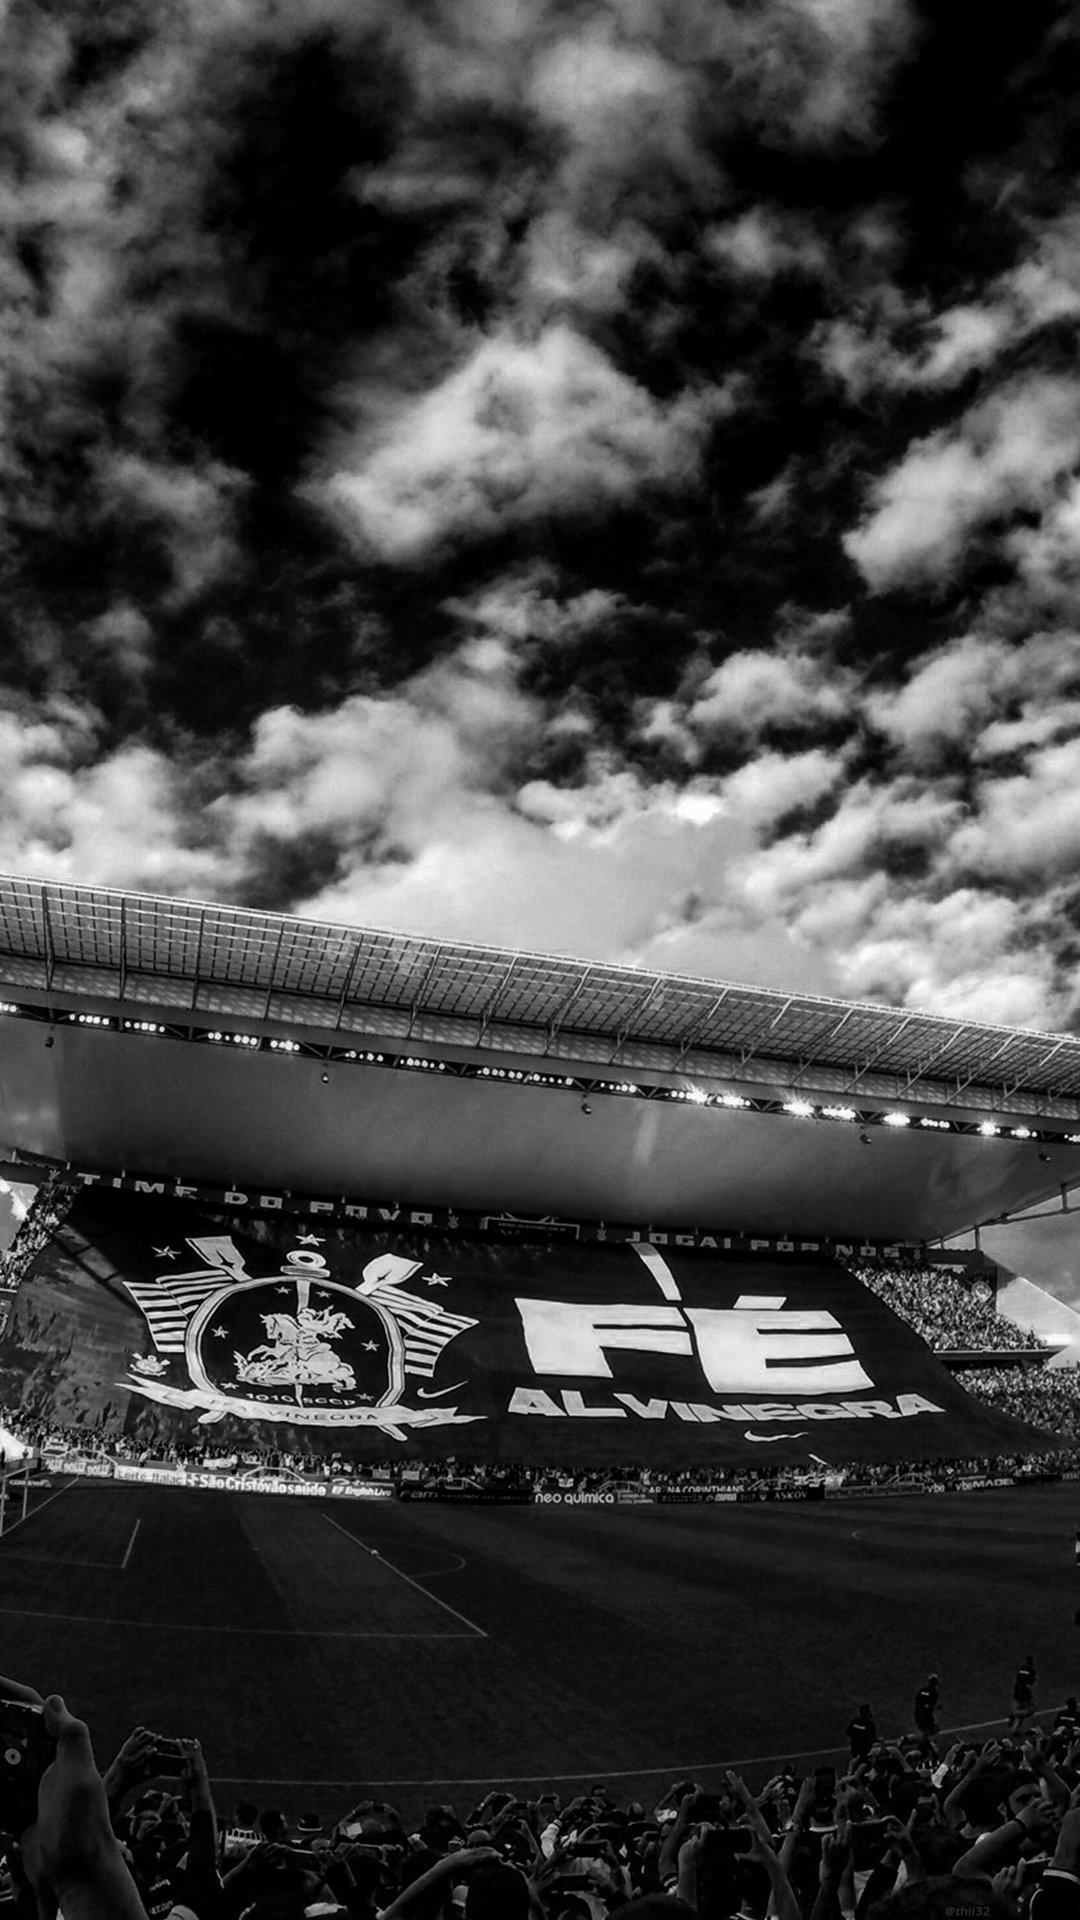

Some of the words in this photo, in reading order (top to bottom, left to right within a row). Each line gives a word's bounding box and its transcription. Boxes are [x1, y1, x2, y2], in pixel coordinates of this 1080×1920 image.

[76, 1172, 198, 1200] TIME
[224, 1191, 283, 1210] DO
[310, 1201, 433, 1225] POVO
[625, 1230, 731, 1248] JOGAI
[751, 1239, 819, 1252] POR
[514, 1295, 875, 1395] FÉ
[508, 1387, 946, 1422] ALVINEGRA
[535, 1493, 561, 1504] neo
[649, 1485, 681, 1493] ARNA
[774, 1490, 808, 1500] ASKOV
